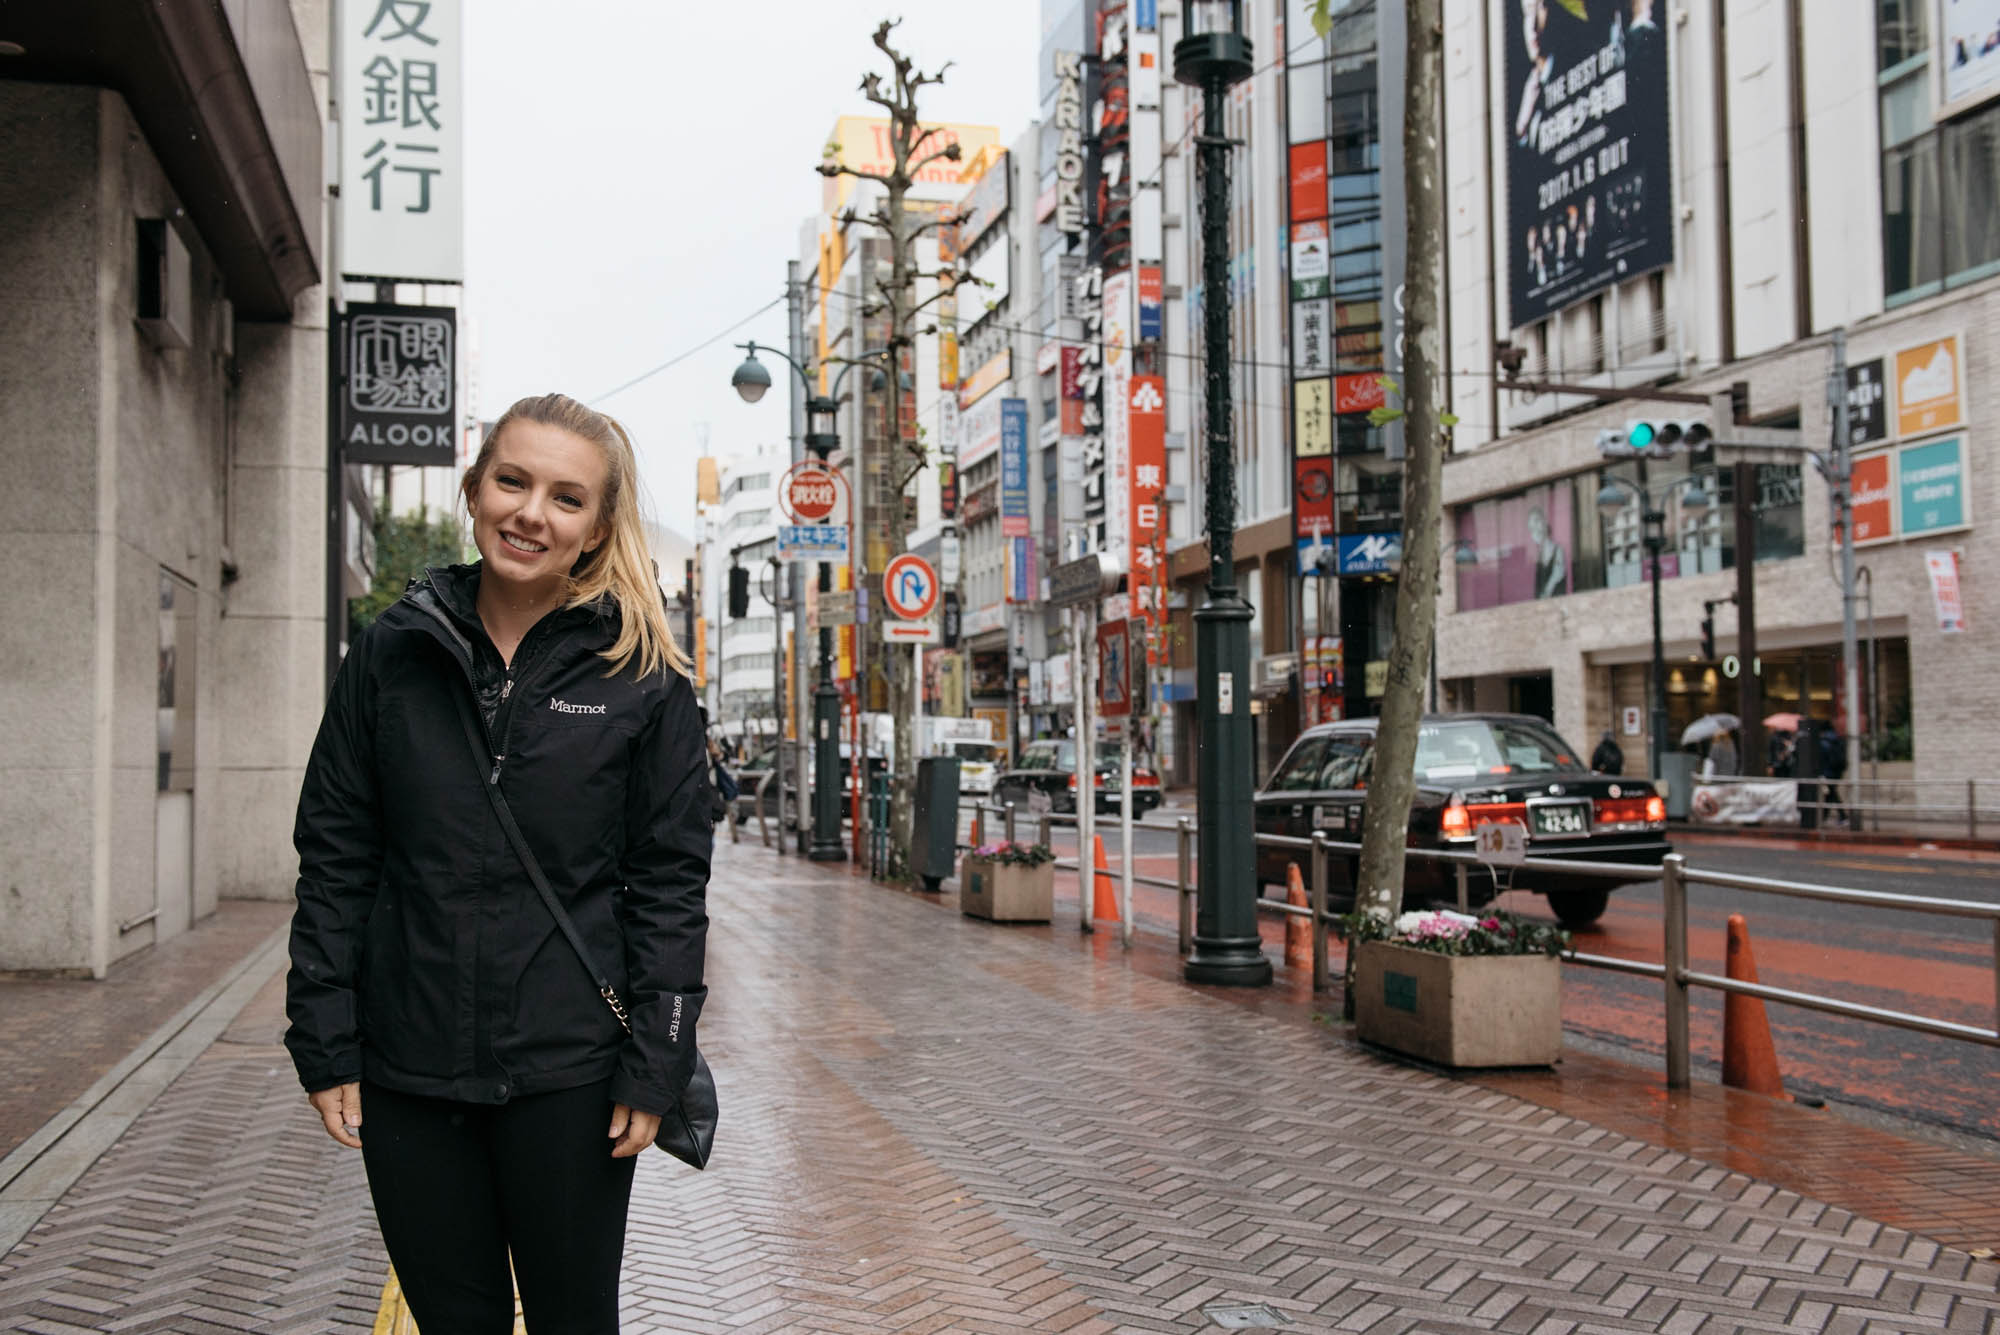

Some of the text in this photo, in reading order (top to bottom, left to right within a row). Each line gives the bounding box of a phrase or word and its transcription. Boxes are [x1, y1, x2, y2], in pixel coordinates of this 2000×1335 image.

[1544, 74, 1567, 110] THE
[1566, 53, 1598, 96] BEST
[1055, 52, 1084, 232] KARAOKE
[1598, 137, 1630, 177] OUT
[350, 423, 451, 447] ALOOK
[1135, 465, 1163, 650] 東日本銀
[549, 697, 607, 715] Marmot
[1544, 814, 1582, 833] 42-04
[669, 995, 683, 1039] GORE-TEX
